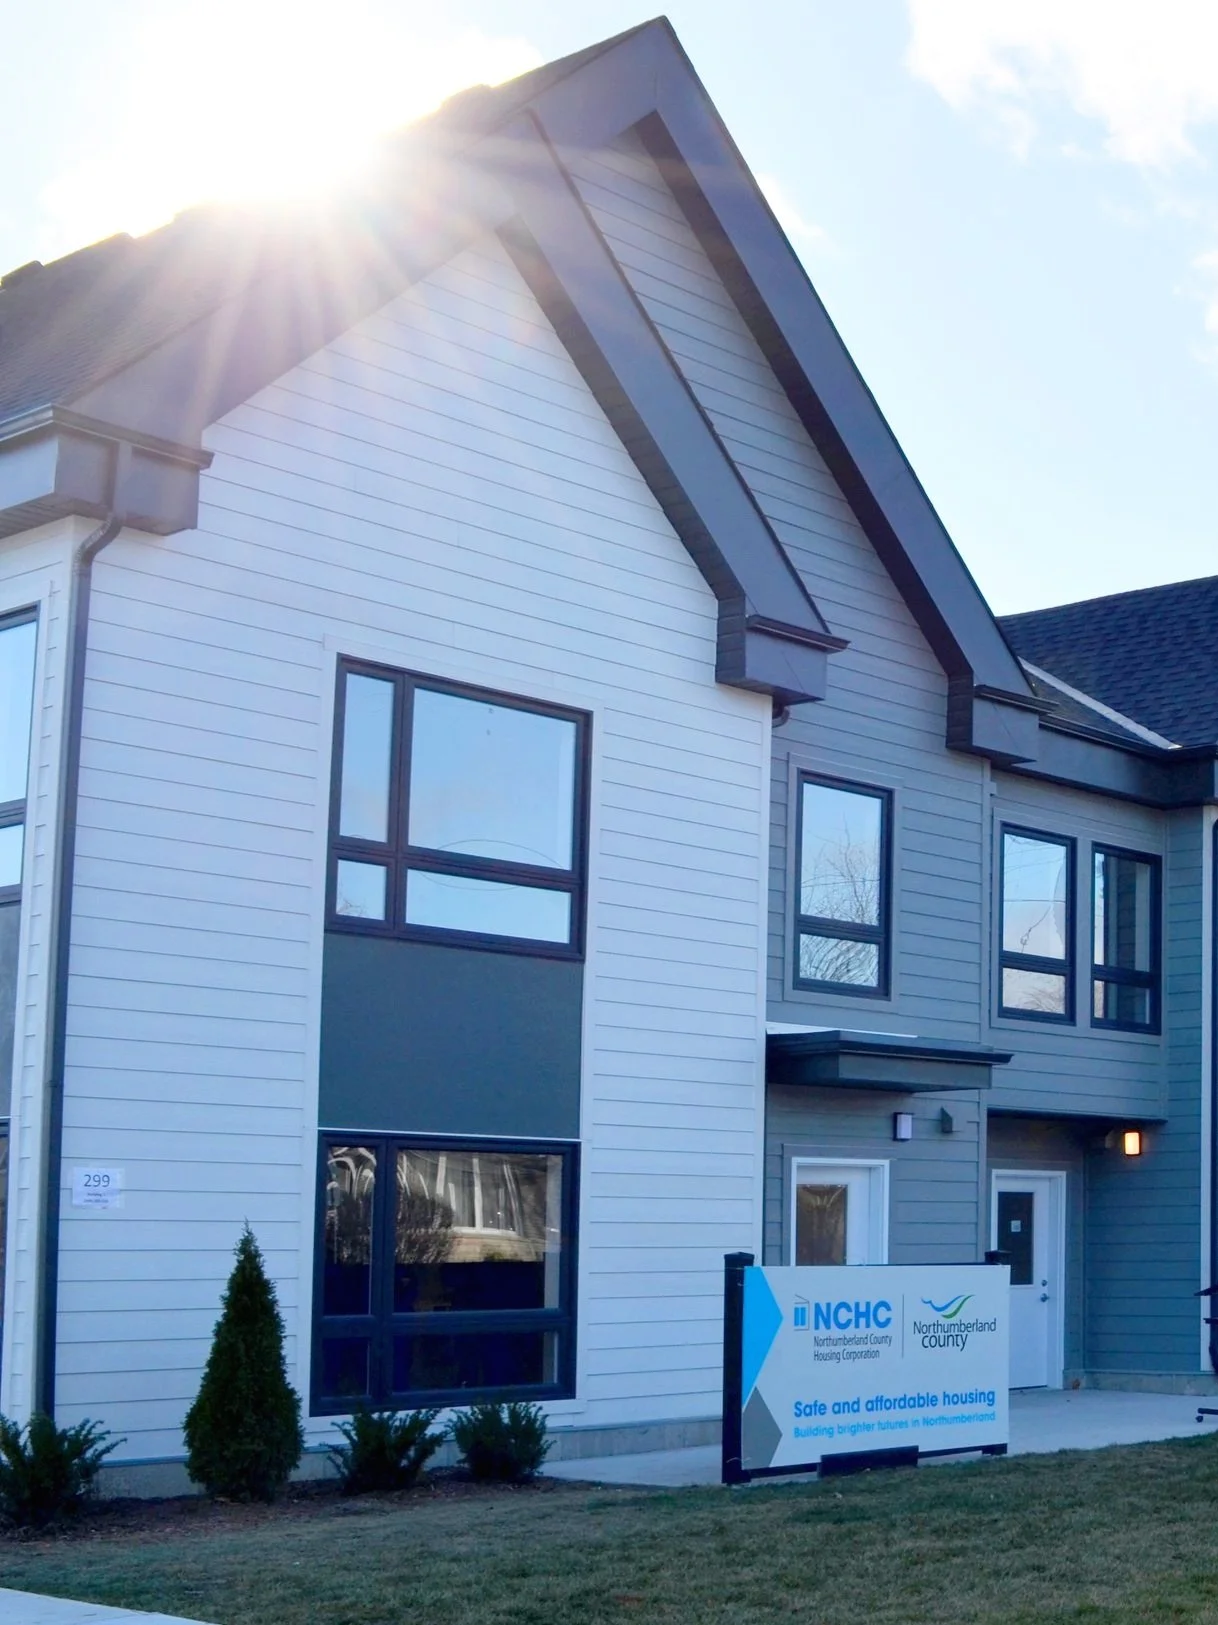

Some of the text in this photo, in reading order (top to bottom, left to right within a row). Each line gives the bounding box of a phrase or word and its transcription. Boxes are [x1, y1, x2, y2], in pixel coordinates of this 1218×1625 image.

[84, 1174, 110, 1187] 299
[814, 1301, 892, 1330] NCHC
[914, 1318, 996, 1335] Northumberland
[814, 1333, 892, 1348] Northumberland County
[921, 1334, 968, 1352] county
[814, 1348, 880, 1363] Housing Corporation
[794, 1389, 996, 1418] Safe and affordable housing
[794, 1412, 996, 1438] Building brighter futures in Northumberland
